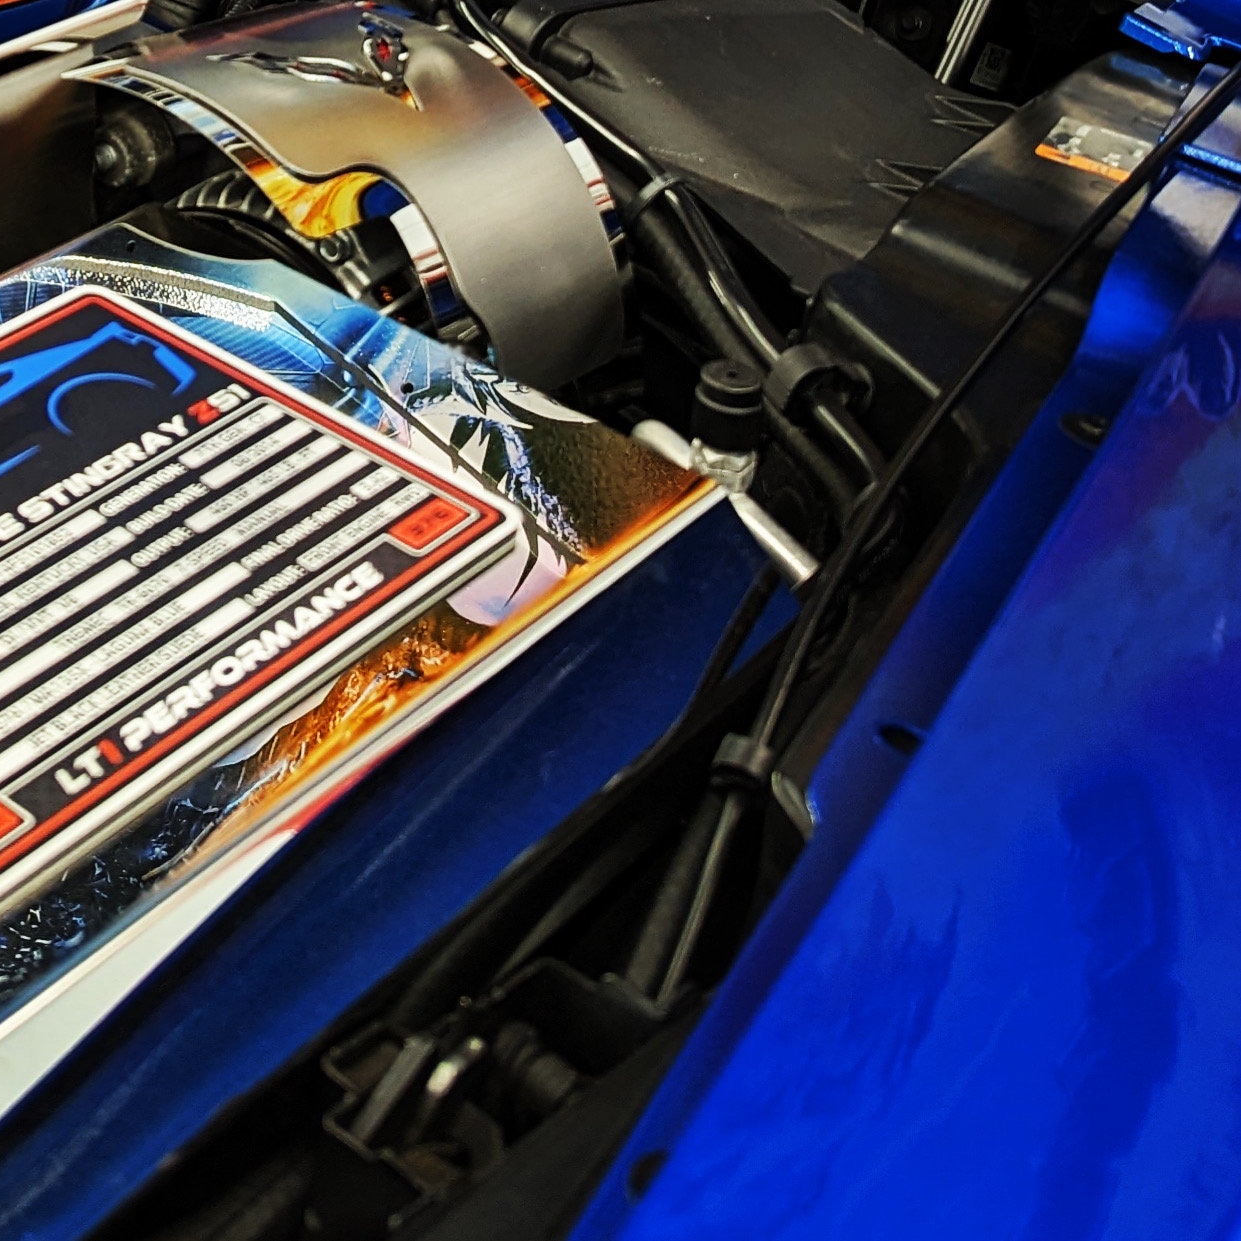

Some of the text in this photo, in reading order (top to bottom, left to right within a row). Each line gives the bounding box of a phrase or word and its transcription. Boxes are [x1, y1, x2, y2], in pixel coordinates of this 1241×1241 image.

[16, 414, 188, 523] STINGRAY
[187, 383, 250, 423] Z51
[98, 462, 187, 516] GENERATION:
[125, 504, 172, 534] BUILD
[162, 482, 209, 511] DATE:
[130, 526, 194, 567] OUTPUT:
[238, 540, 285, 570] FINAL
[273, 517, 321, 547] DRIVE
[244, 564, 305, 606] LAYOUT:
[54, 560, 384, 794] LT1 PERFORMANCE
